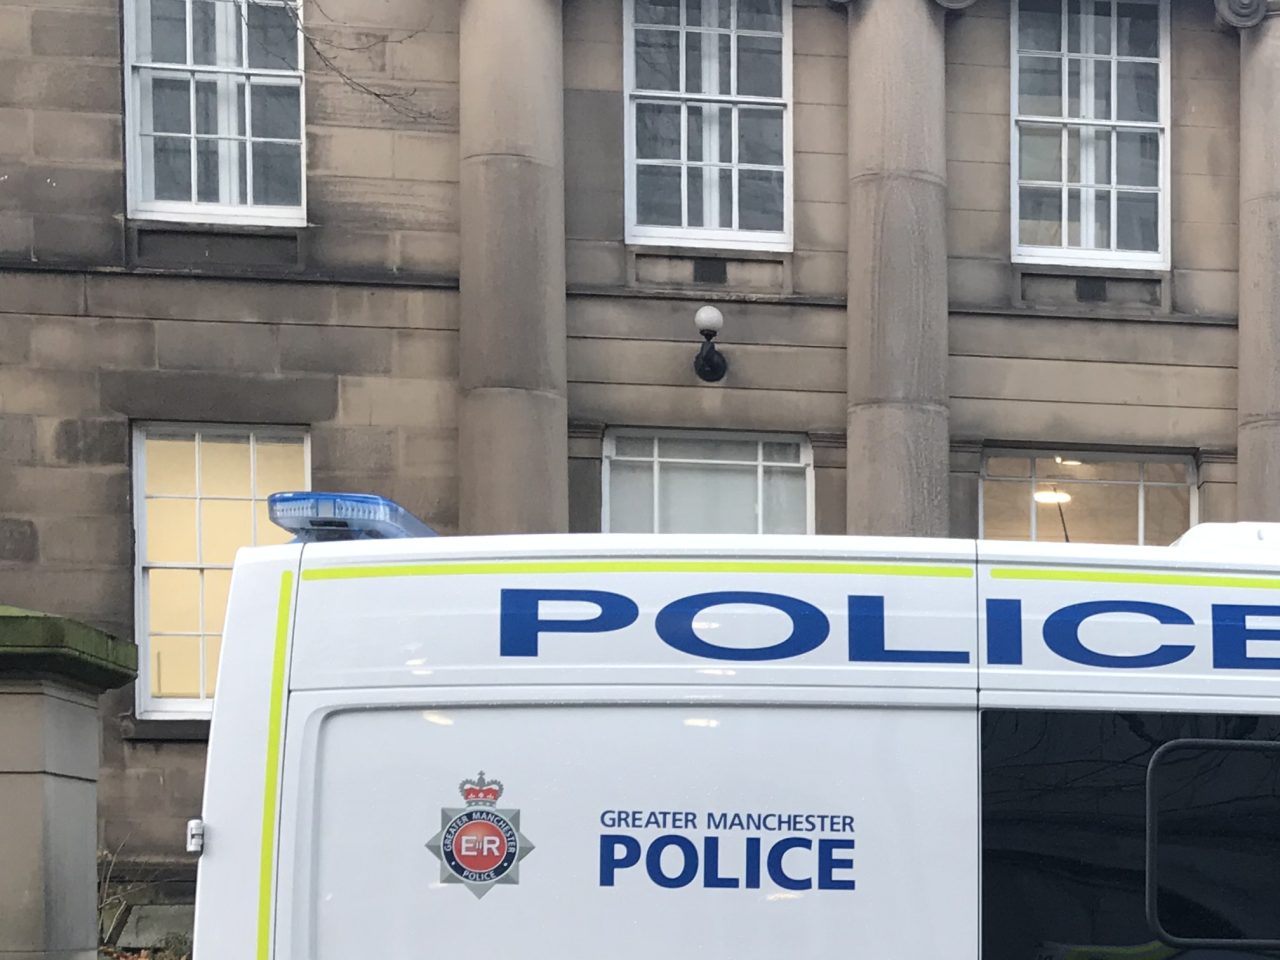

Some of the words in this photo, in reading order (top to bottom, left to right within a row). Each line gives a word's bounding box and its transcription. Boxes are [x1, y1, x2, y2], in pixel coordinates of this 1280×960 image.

[444, 816, 469, 852] GREATER
[472, 812, 516, 853] MANCHESTER
[600, 810, 697, 829] GREATER
[707, 812, 855, 832] MANCHESTER
[462, 870, 497, 881] POLICE
[599, 834, 855, 890] POLICE
